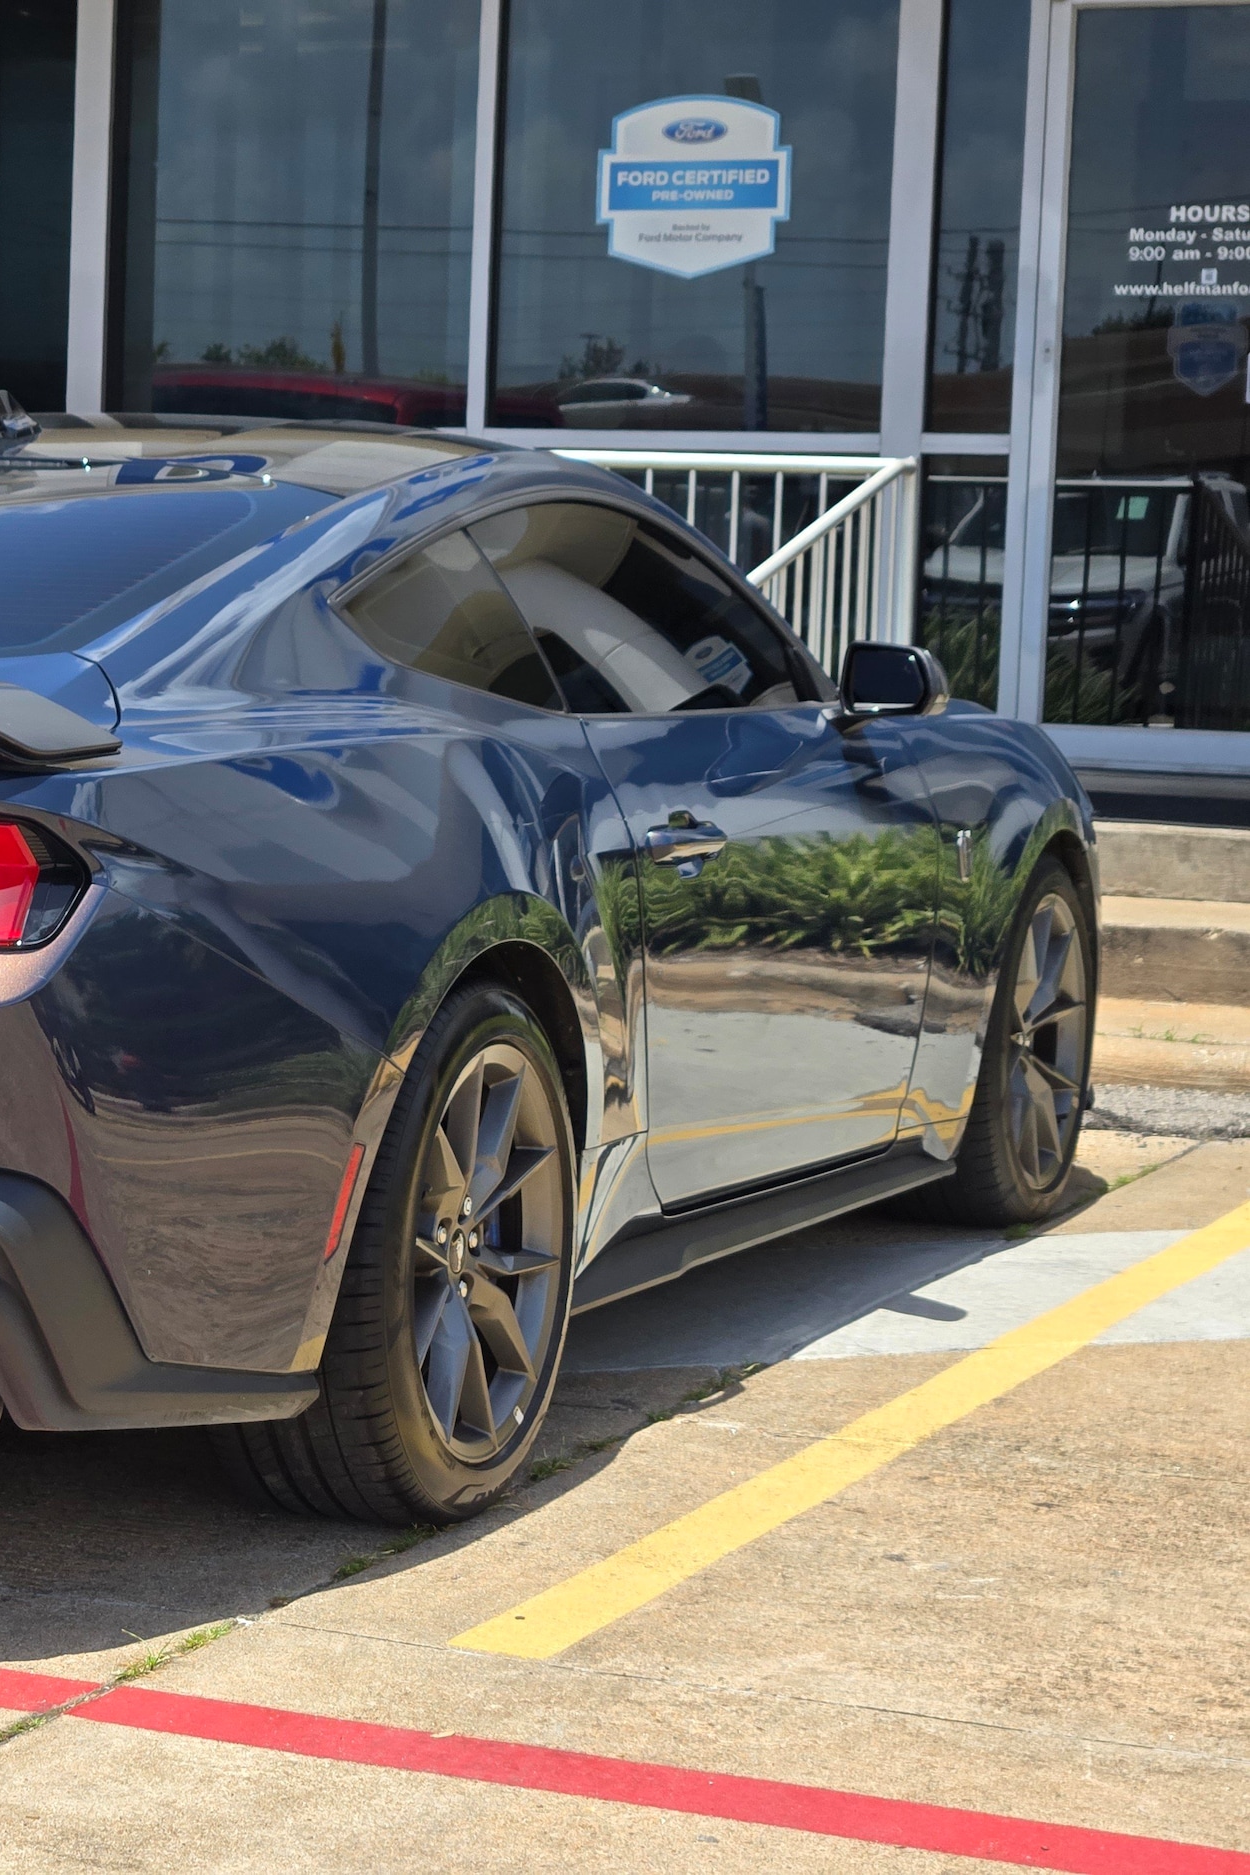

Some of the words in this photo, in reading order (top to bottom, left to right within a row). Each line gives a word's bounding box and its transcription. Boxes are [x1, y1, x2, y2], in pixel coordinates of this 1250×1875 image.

[674, 121, 716, 140] Ford
[617, 170, 669, 186] FORD
[672, 168, 770, 185] CERTIFIED
[651, 189, 734, 202] PRE-OWNED
[638, 232, 661, 242] Ford
[663, 232, 693, 242] Motor
[694, 232, 743, 243] Company
[1129, 227, 1197, 245] Monday
[1128, 246, 1166, 261] 9:00
[1172, 249, 1201, 261] am
